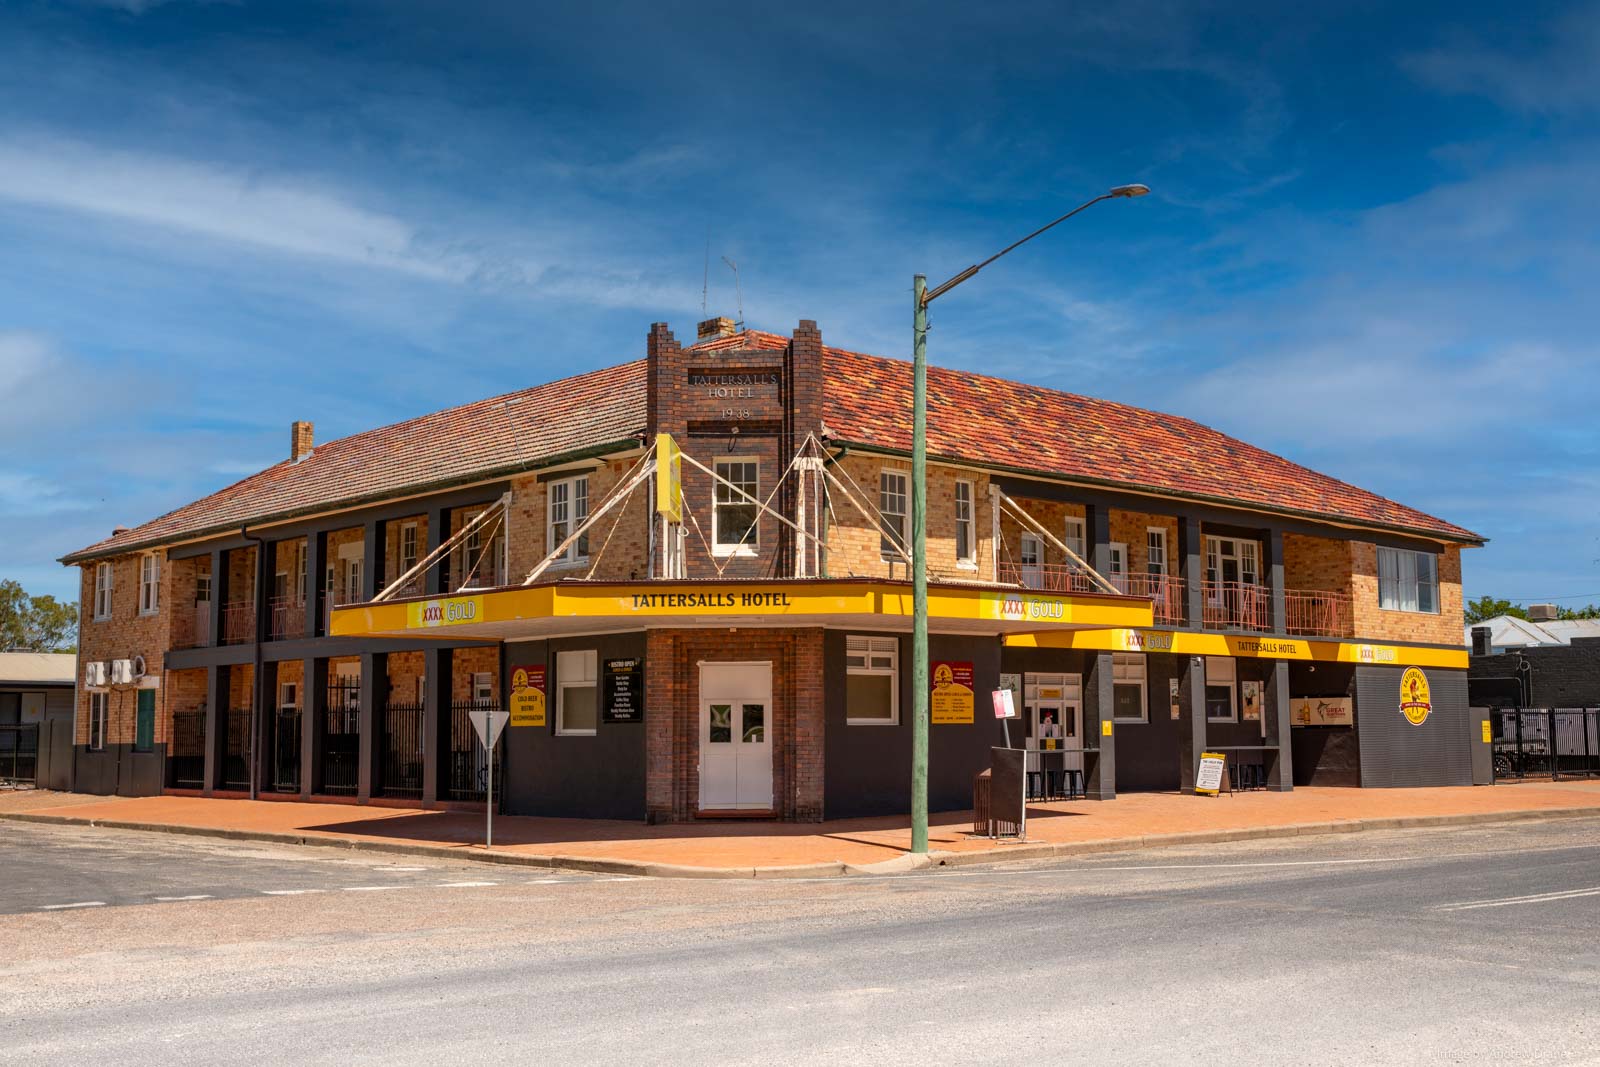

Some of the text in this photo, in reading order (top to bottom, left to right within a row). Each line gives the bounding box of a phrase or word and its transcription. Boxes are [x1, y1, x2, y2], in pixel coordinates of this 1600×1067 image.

[708, 387, 754, 399] HOTEL
[631, 592, 791, 607] TATTERSALLS HOTEL
[422, 600, 476, 622] XXXX GOLD
[1000, 598, 1063, 618] XXXX GOLD
[1126, 634, 1171, 650] XXXX GOLD
[1237, 640, 1297, 654] TATTERSALLS HOTEL
[1361, 648, 1394, 661] XXXX GOLD
